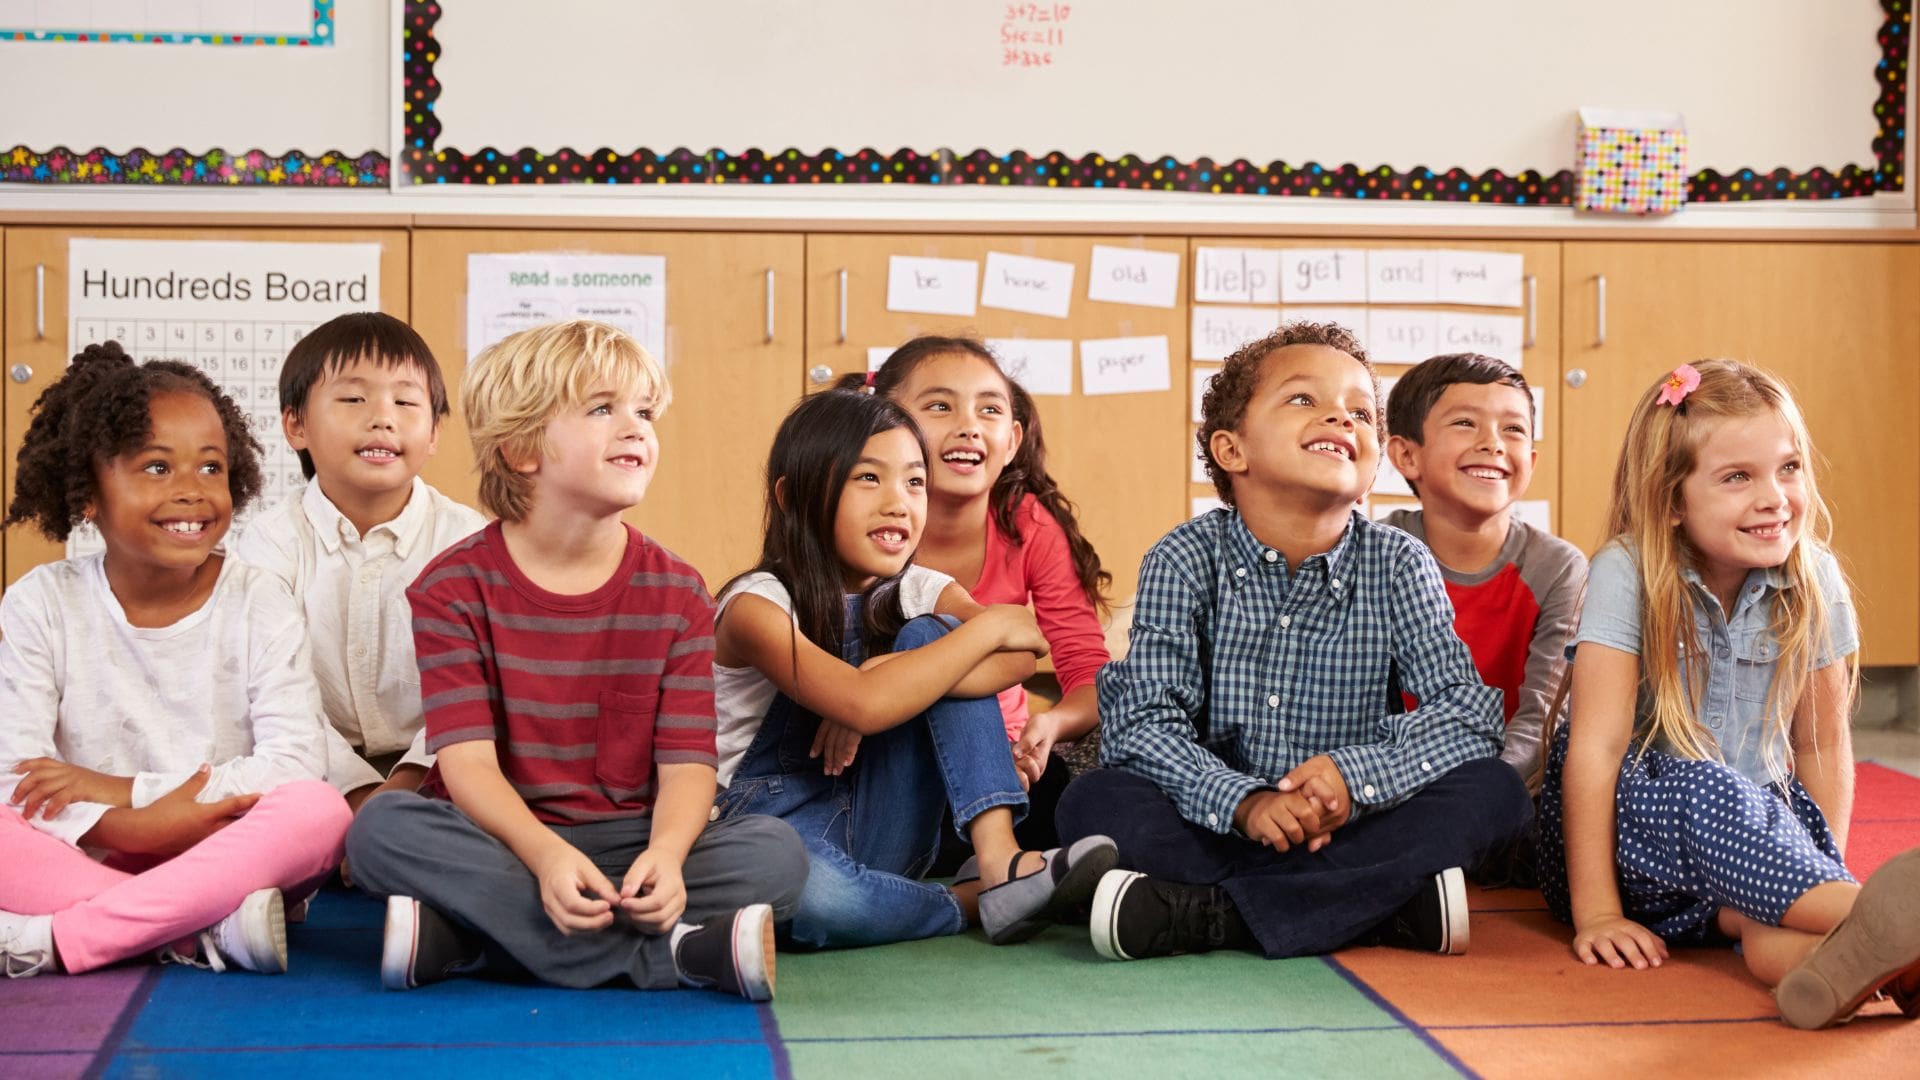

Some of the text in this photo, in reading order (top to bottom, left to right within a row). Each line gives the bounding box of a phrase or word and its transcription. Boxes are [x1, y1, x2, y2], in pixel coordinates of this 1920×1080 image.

[509, 271, 549, 287] Read
[572, 272, 653, 287] someone
[914, 270, 941, 290] be
[1203, 251, 1267, 300] help
[1297, 251, 1344, 291] get
[1380, 258, 1424, 283] and
[83, 269, 367, 303] Hundreds Board
[88, 326, 95, 339] 1
[116, 326, 127, 340] 2
[146, 327, 156, 341] 3
[174, 328, 185, 341] 4
[205, 327, 215, 342] 5
[234, 327, 244, 342] 6
[263, 328, 274, 342] 7
[1386, 324, 1426, 349] up
[202, 357, 219, 372] 15
[231, 357, 248, 371] 16
[260, 357, 278, 371] 17
[260, 386, 277, 399] 27
